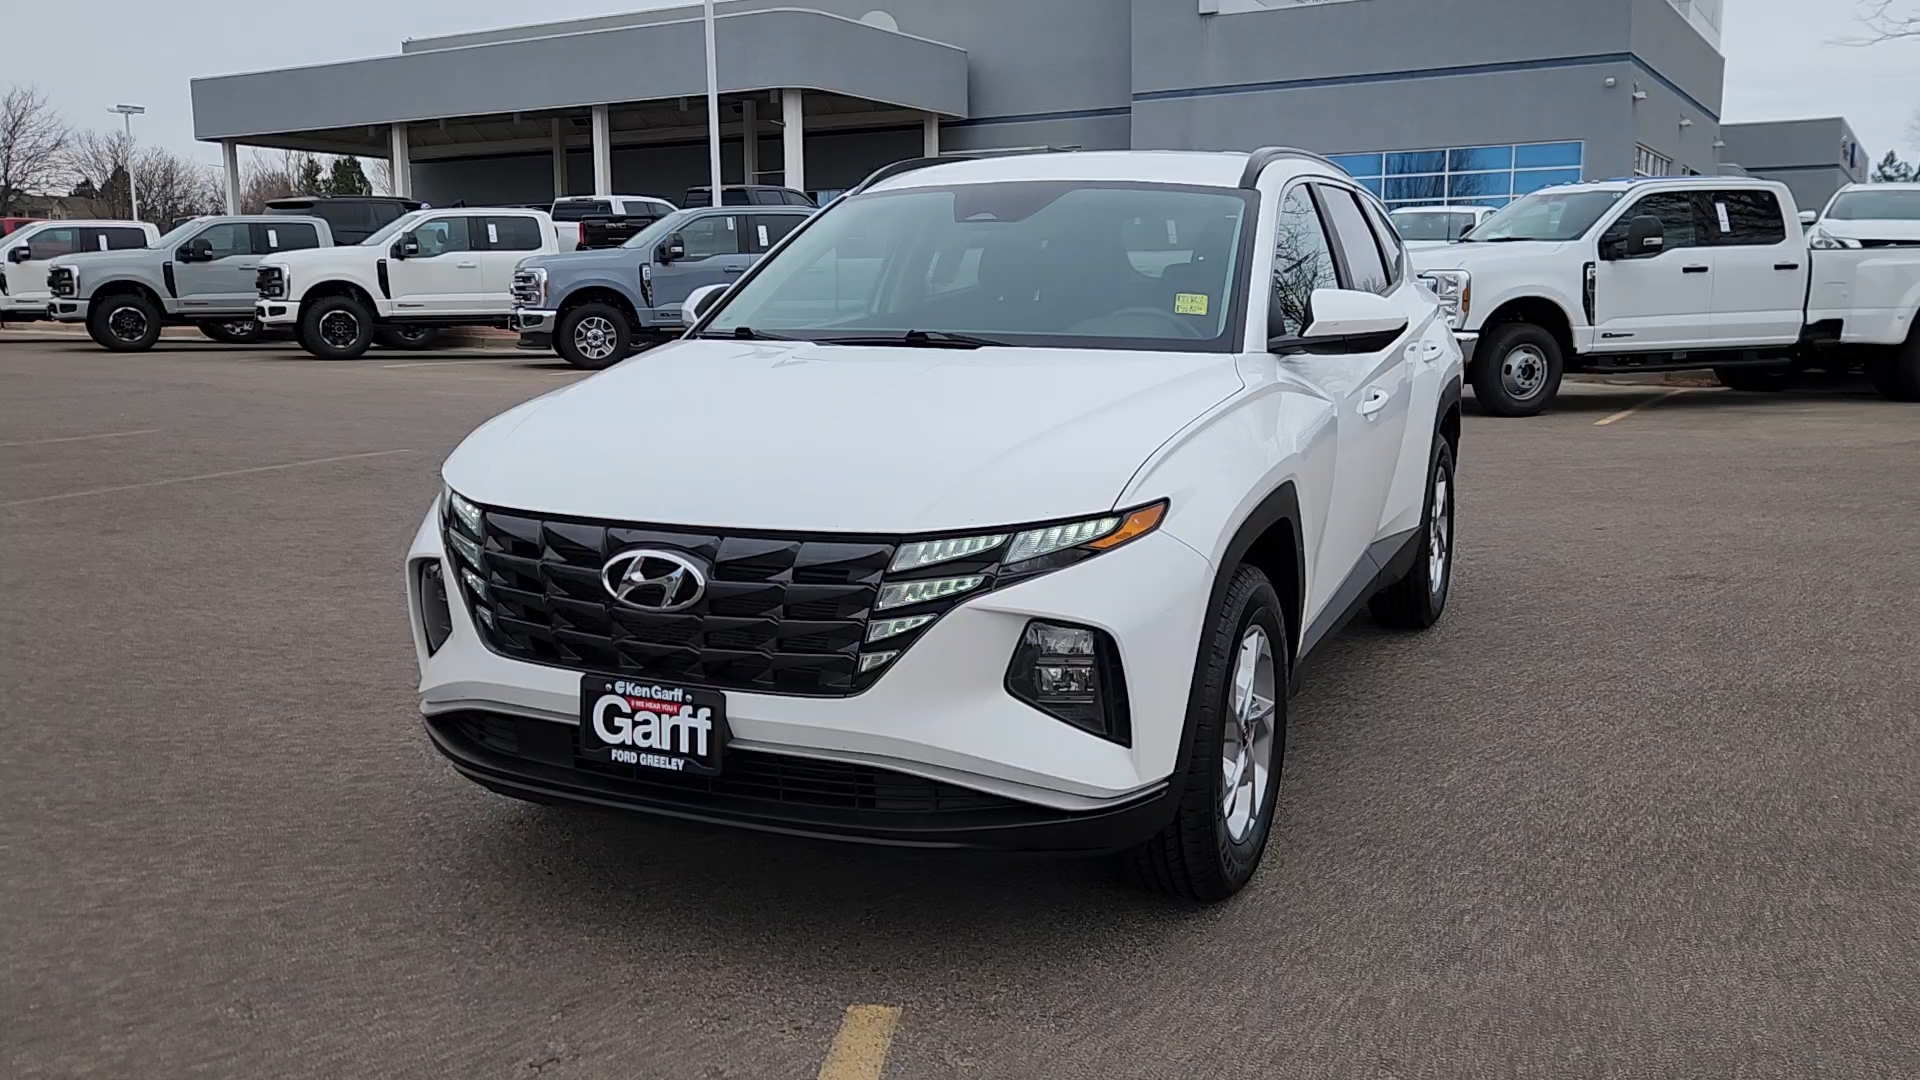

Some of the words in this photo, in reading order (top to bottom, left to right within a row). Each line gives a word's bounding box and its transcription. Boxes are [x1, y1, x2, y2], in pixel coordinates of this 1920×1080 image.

[626, 681, 650, 698] Ken
[651, 685, 683, 702] Garff
[635, 700, 645, 708] WE
[645, 701, 660, 710] HEAR
[661, 704, 674, 712] YOU
[593, 694, 712, 756] Garff
[611, 749, 638, 764] FORD
[640, 753, 685, 771] GREELEY
